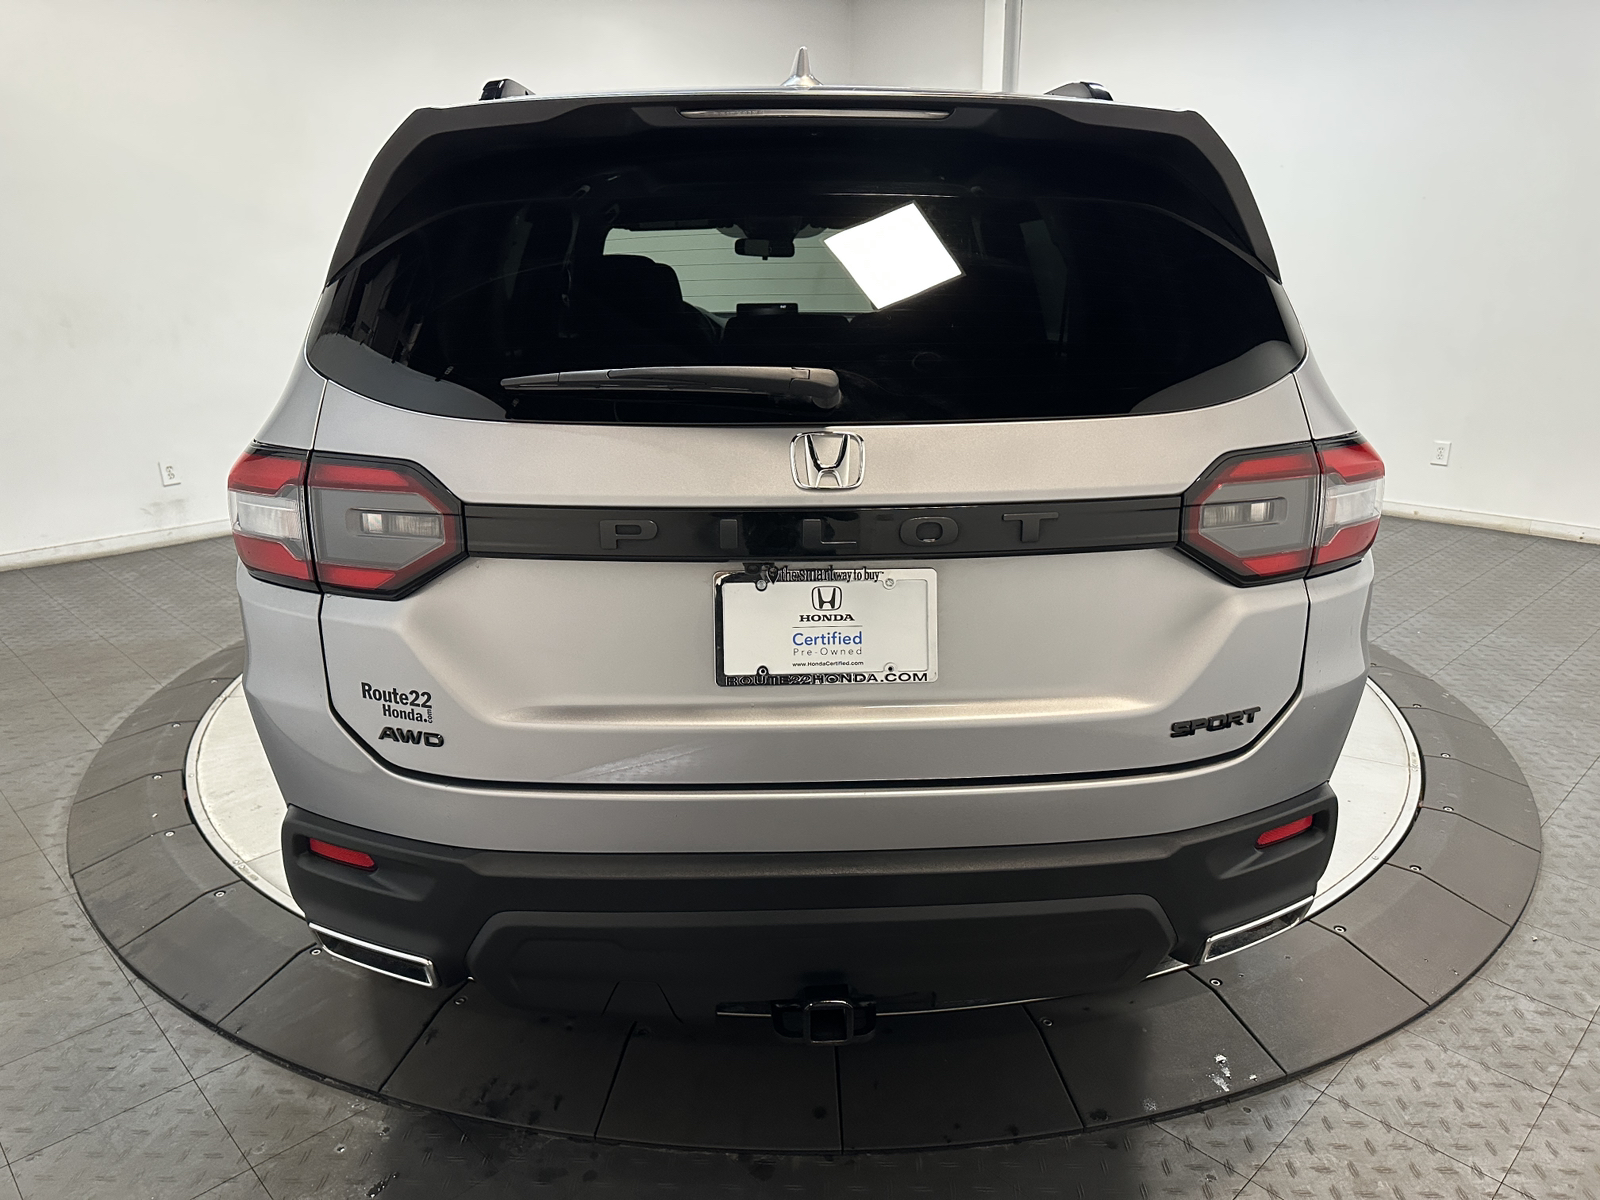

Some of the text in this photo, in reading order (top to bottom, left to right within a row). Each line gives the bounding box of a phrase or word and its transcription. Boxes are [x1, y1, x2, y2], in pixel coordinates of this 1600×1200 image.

[600, 512, 1058, 550] PILOT
[835, 570, 852, 583] way
[854, 568, 862, 581] to
[799, 614, 855, 622] HONDA
[792, 631, 863, 646] Certified
[793, 647, 862, 656] Pre-Owned
[361, 682, 432, 709] Route22
[1170, 706, 1261, 738] SPORT
[378, 726, 445, 748] AWD
